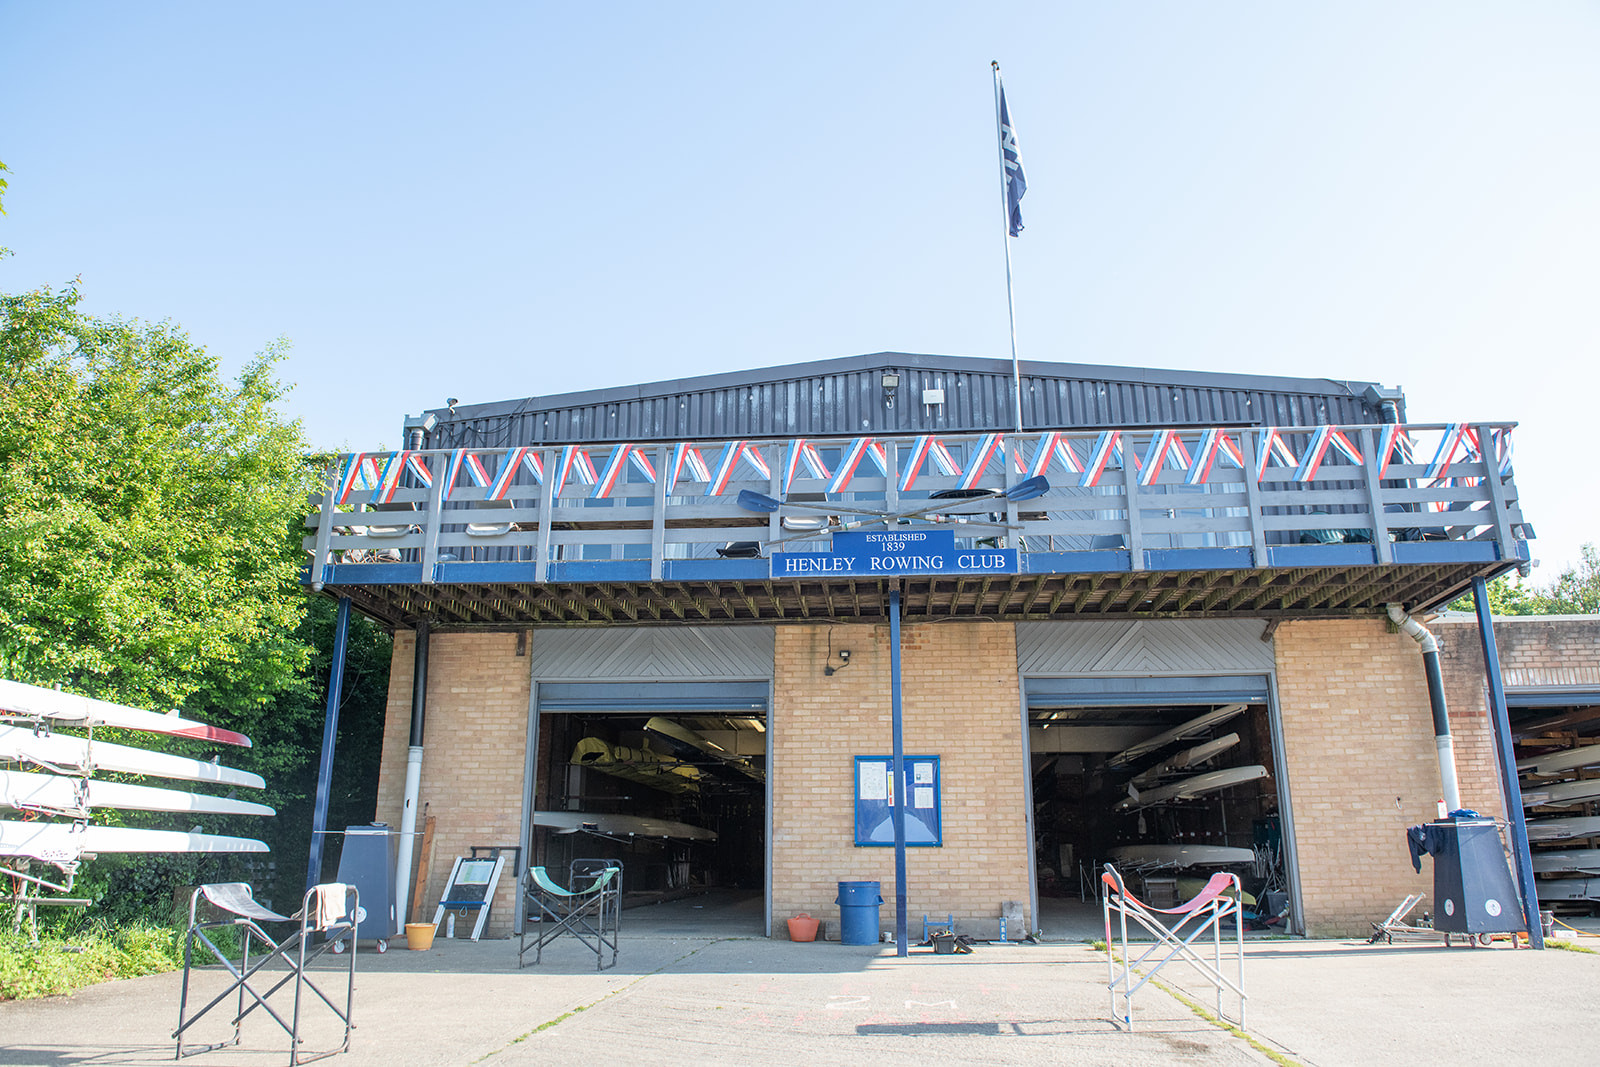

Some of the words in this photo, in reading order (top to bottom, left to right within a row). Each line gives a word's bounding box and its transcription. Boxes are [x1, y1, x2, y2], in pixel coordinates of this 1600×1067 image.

[865, 533, 927, 543] ESTABLISHED
[881, 542, 906, 552] 1839
[785, 557, 856, 573] HENLEY
[870, 555, 944, 571] ROWING
[957, 554, 1006, 569] CLUB
